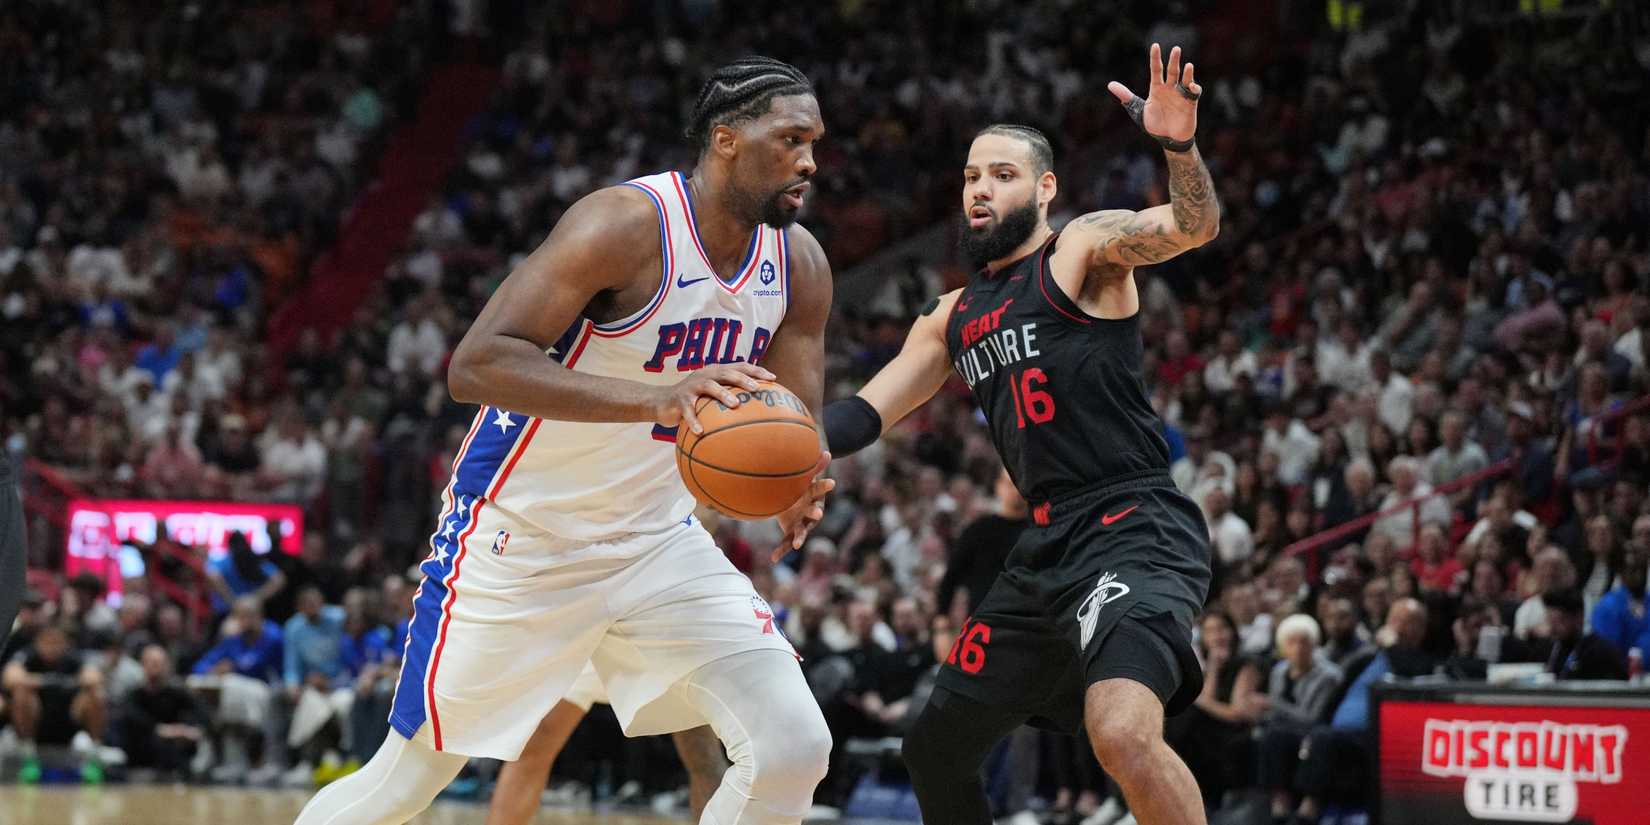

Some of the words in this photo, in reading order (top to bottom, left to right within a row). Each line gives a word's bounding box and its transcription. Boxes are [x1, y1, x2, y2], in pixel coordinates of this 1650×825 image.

[960, 298, 1014, 348] HEAT
[1010, 367, 1055, 429] 16
[947, 616, 991, 675] 16
[1427, 726, 1619, 776] DISCOUNT
[1480, 782, 1560, 809] TIRE
